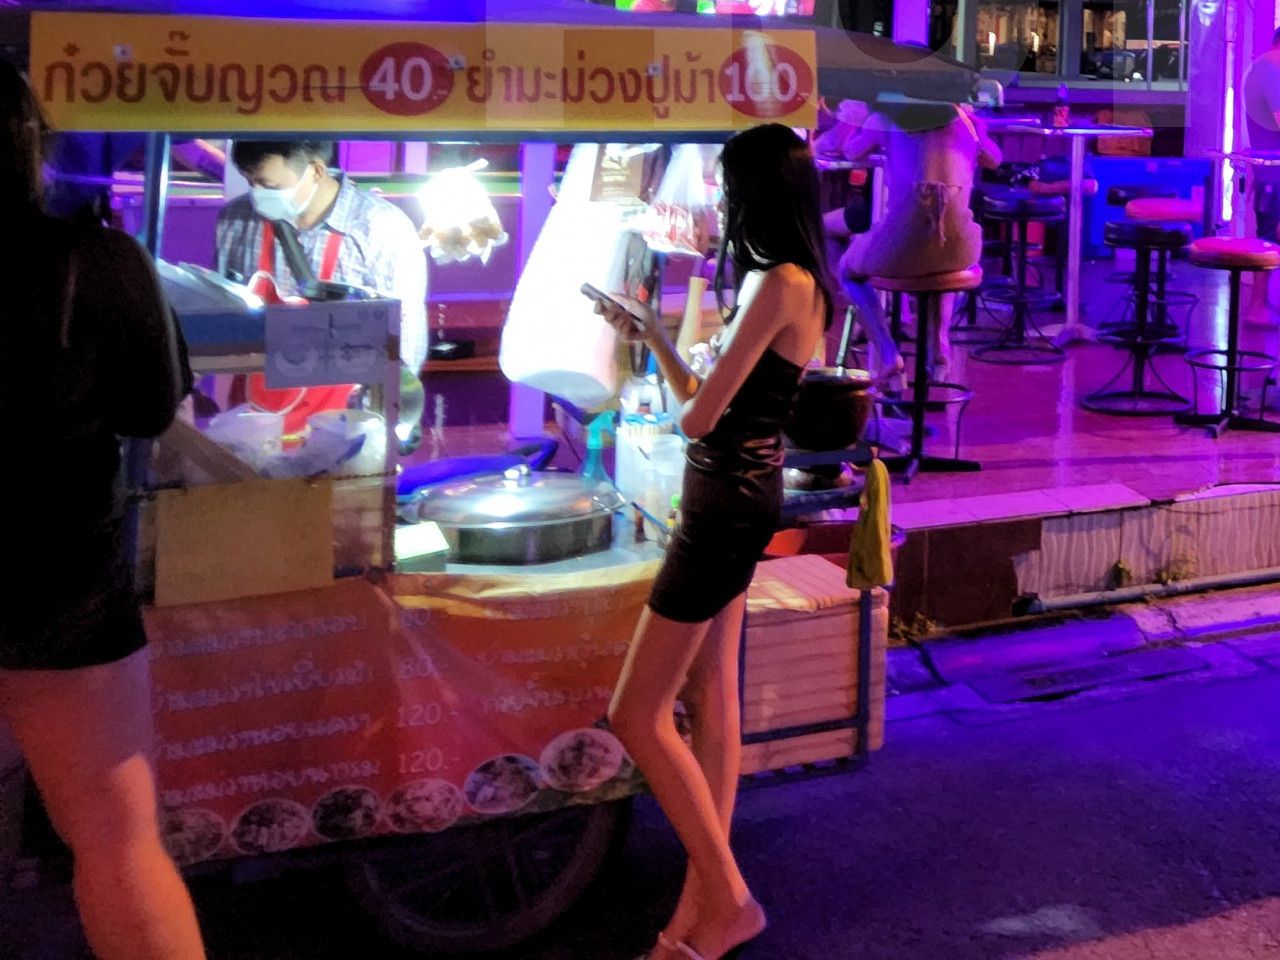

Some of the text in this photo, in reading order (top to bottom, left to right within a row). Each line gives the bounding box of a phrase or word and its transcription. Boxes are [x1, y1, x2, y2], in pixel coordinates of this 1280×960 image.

[466, 48, 717, 119] ยำมะม่วงปูม้า
